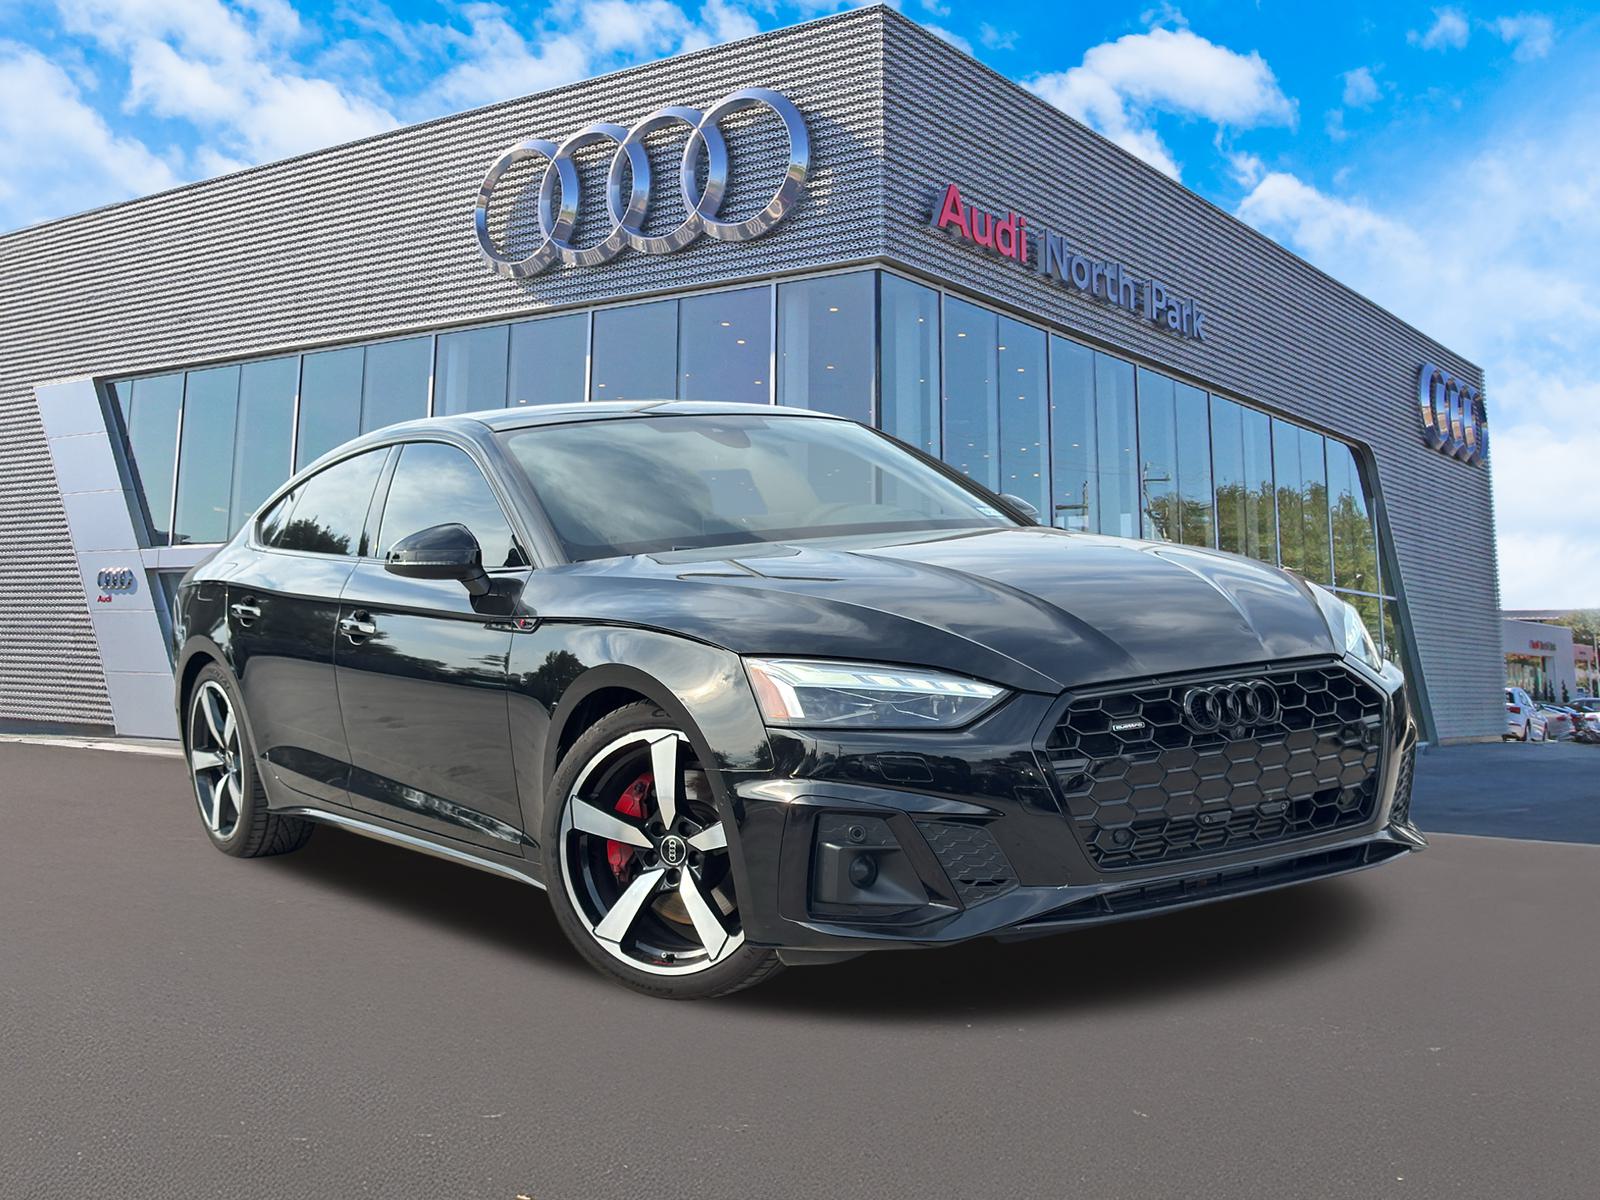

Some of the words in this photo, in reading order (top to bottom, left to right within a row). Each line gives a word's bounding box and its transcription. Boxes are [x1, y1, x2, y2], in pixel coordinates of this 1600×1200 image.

[935, 184, 1027, 263] Audi
[1043, 230, 1136, 310] North
[1149, 280, 1208, 340] Park
